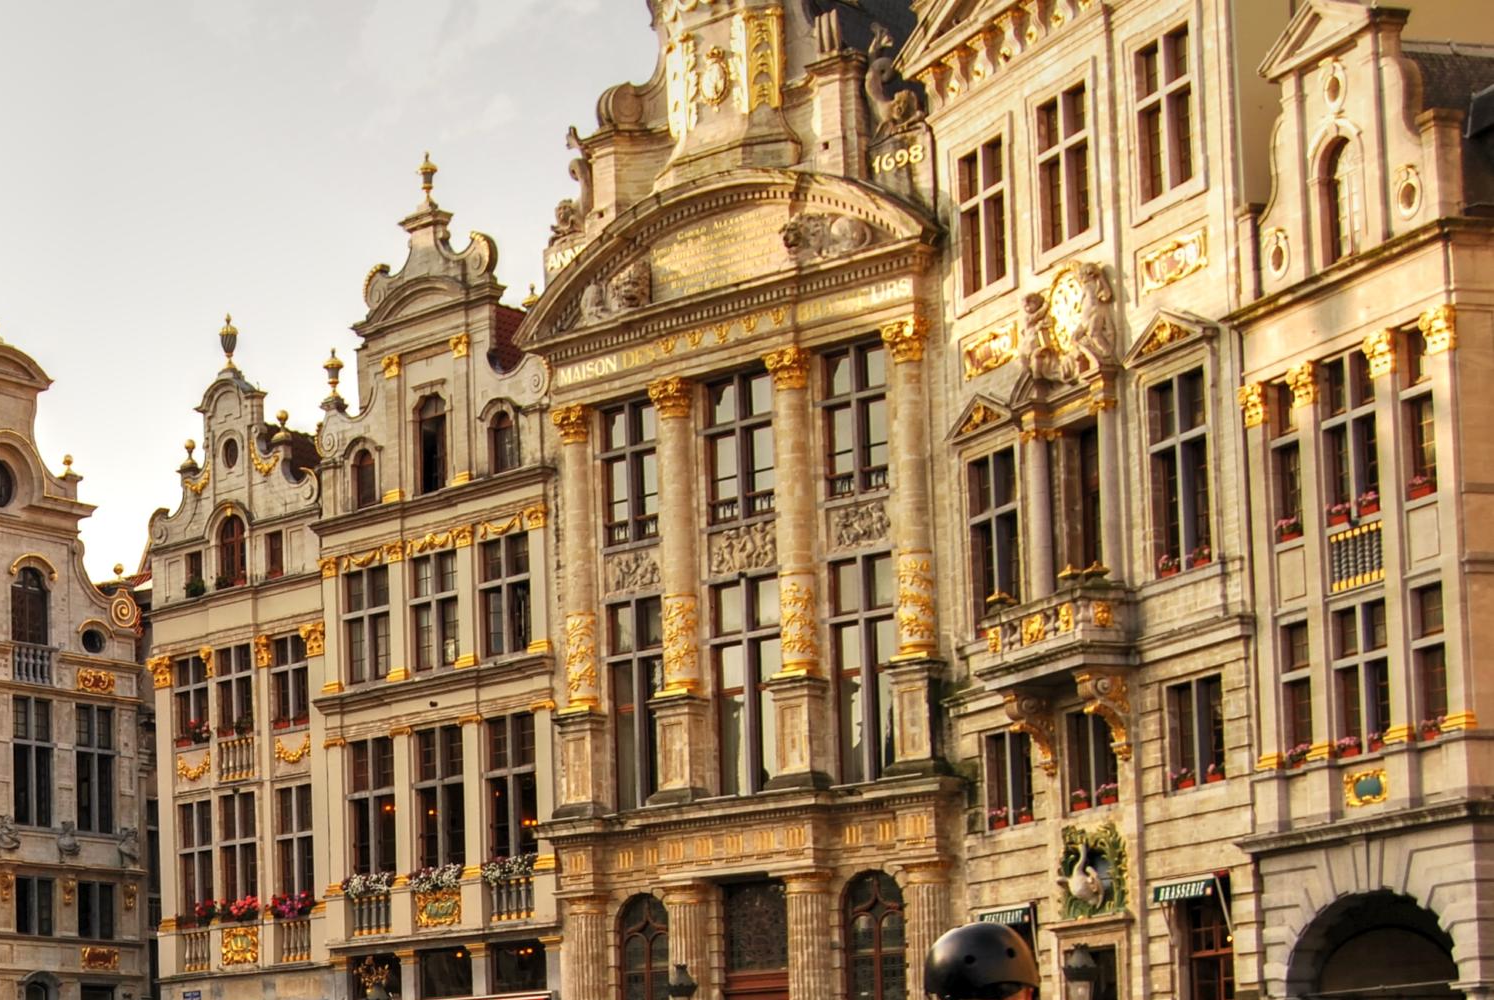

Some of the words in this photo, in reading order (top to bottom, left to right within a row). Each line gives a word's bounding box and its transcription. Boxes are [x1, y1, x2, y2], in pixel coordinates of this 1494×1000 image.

[872, 144, 924, 174] 1698
[547, 244, 585, 272] ANN
[559, 355, 618, 387] MAISON
[622, 347, 656, 369] DES
[1159, 881, 1205, 901] BRASSERIE
[983, 909, 1023, 924] RESTAURANT
